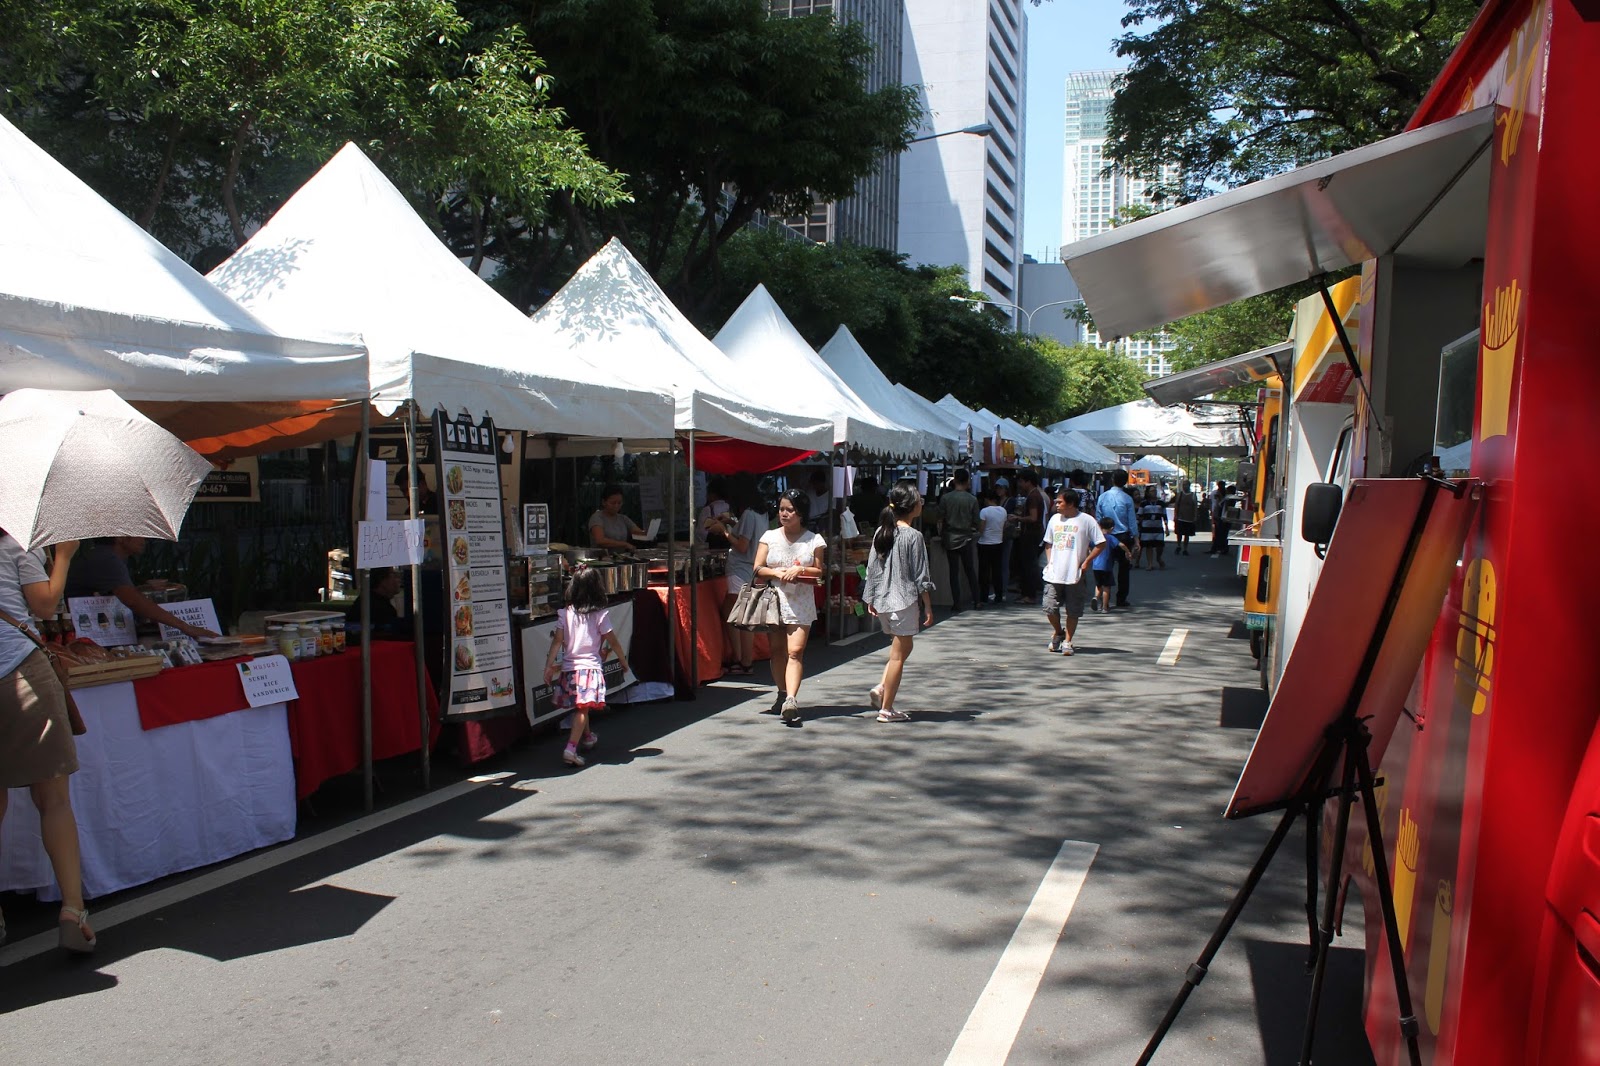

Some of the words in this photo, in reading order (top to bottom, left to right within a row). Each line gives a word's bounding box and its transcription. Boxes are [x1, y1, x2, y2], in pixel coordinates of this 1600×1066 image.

[363, 542, 393, 561] HALO
[252, 661, 279, 671] MUSUBI
[248, 674, 268, 682] SUSHI
[263, 680, 279, 688] RICE
